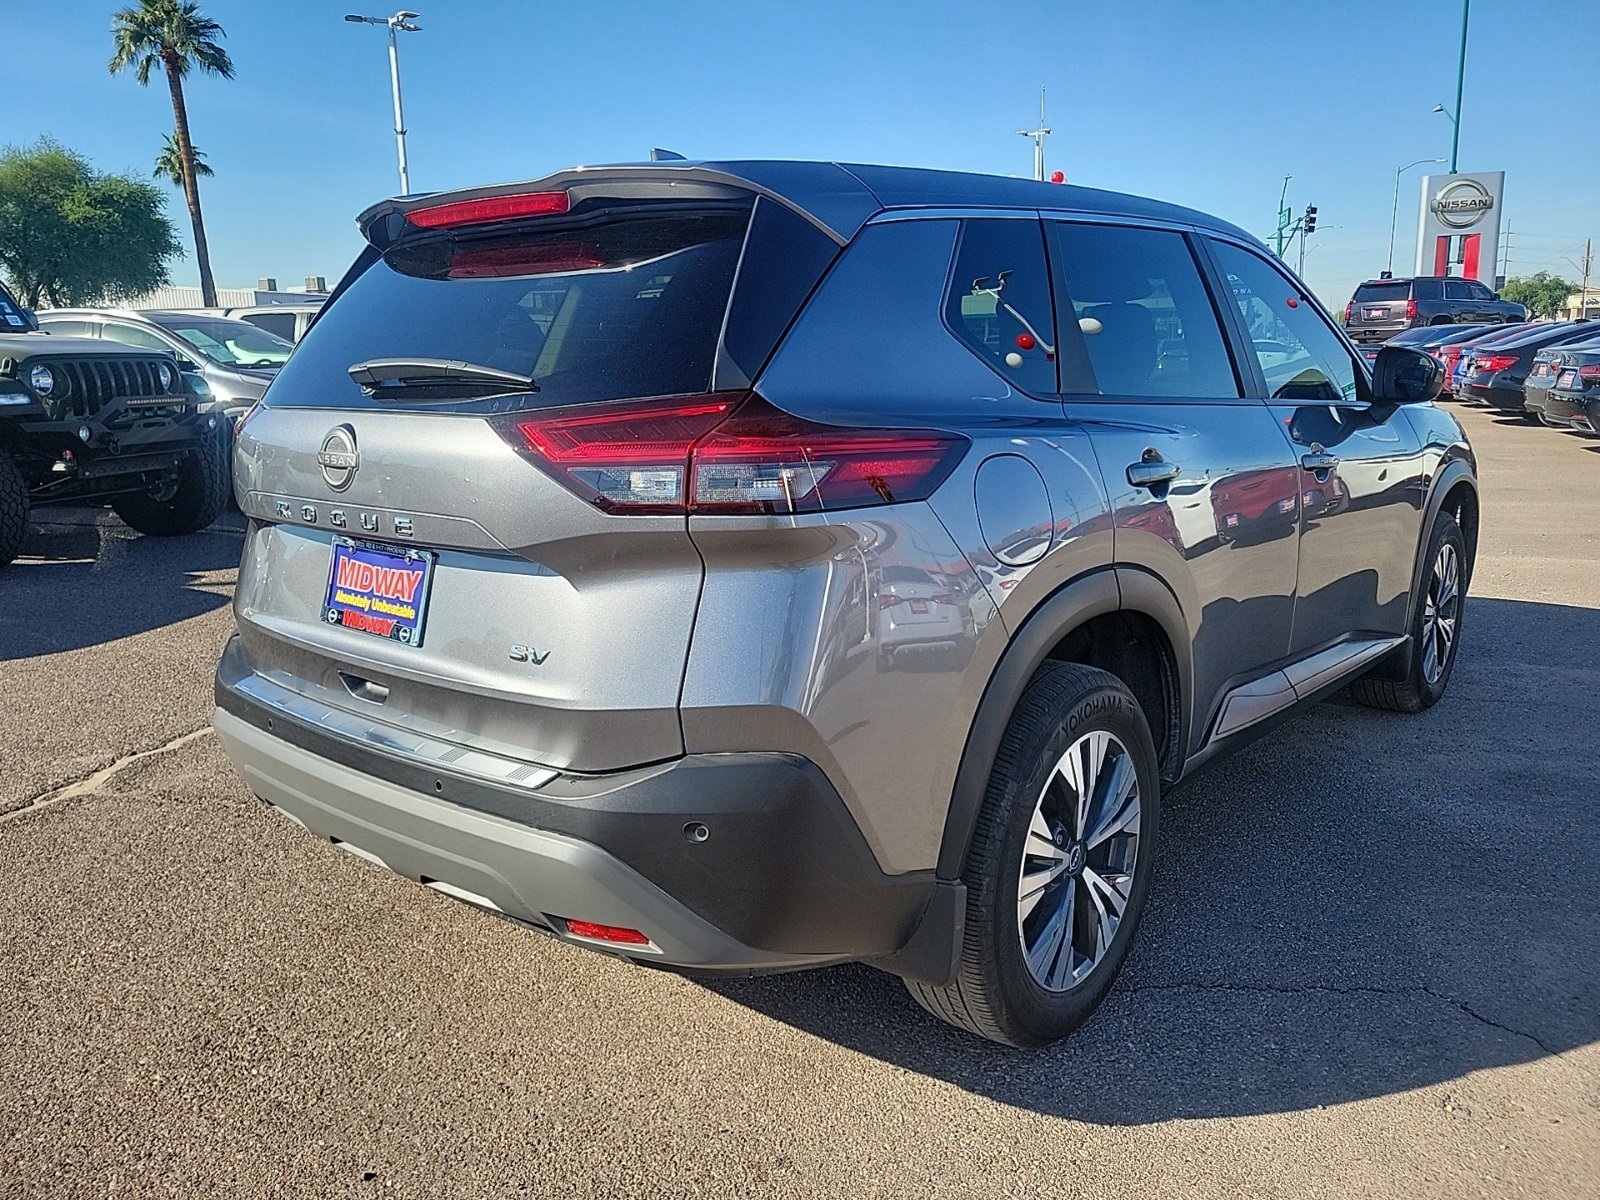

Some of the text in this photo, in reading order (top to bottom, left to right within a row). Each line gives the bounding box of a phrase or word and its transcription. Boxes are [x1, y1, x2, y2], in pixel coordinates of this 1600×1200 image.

[1437, 199, 1488, 209] NISSAN
[317, 454, 355, 467] NSSAN
[276, 500, 413, 537] ROGUE
[336, 556, 423, 603] MIDWAY
[335, 590, 416, 619] Absolutely Unbeatable
[342, 608, 398, 637] MIDWAY
[509, 644, 551, 666] SV
[1061, 695, 1122, 738] YOKOHAMA
